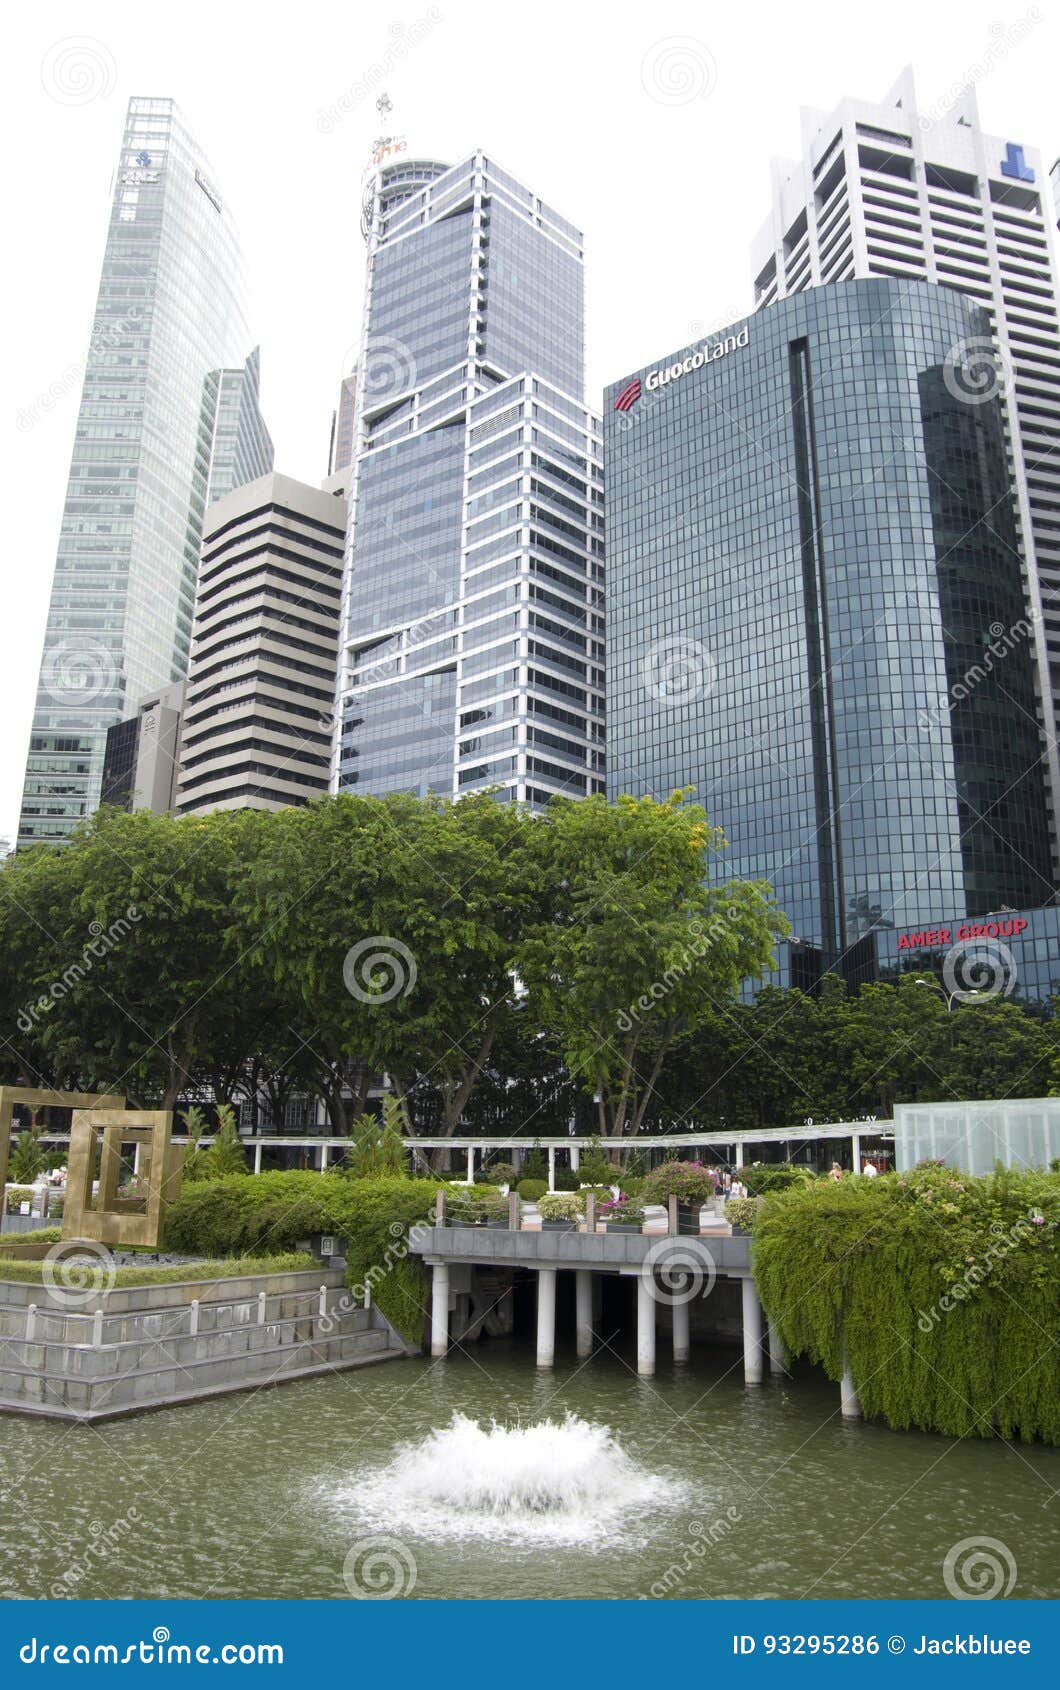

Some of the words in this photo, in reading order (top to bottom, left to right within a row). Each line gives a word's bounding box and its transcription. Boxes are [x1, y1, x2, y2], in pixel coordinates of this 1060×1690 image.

[645, 326, 749, 390] GuocoLand
[897, 930, 950, 949] AMER
[956, 918, 1028, 941] GROUP
